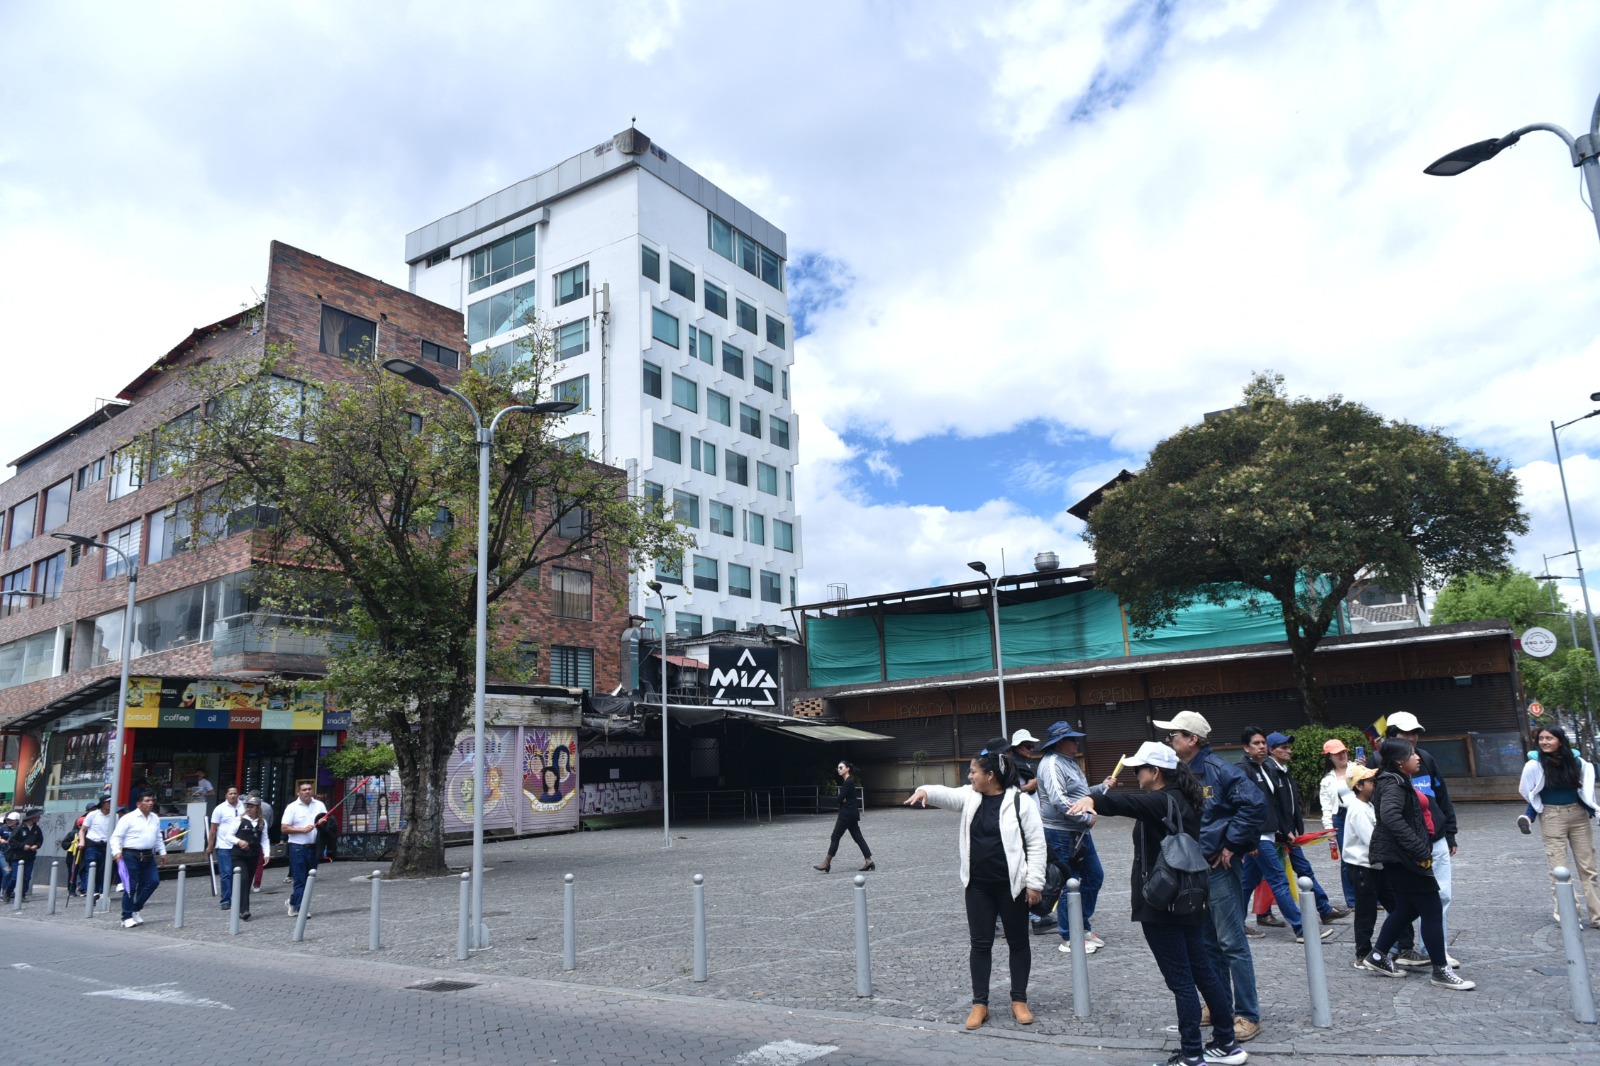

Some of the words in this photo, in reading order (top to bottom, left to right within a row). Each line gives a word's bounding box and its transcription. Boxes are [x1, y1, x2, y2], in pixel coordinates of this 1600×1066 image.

[709, 667, 778, 688] MIA
[1088, 687, 1133, 703] OPEN
[126, 713, 152, 721] bread
[163, 713, 190, 722] coffee
[207, 714, 217, 722] oil
[230, 715, 261, 724] sausage
[326, 717, 348, 725] snacks
